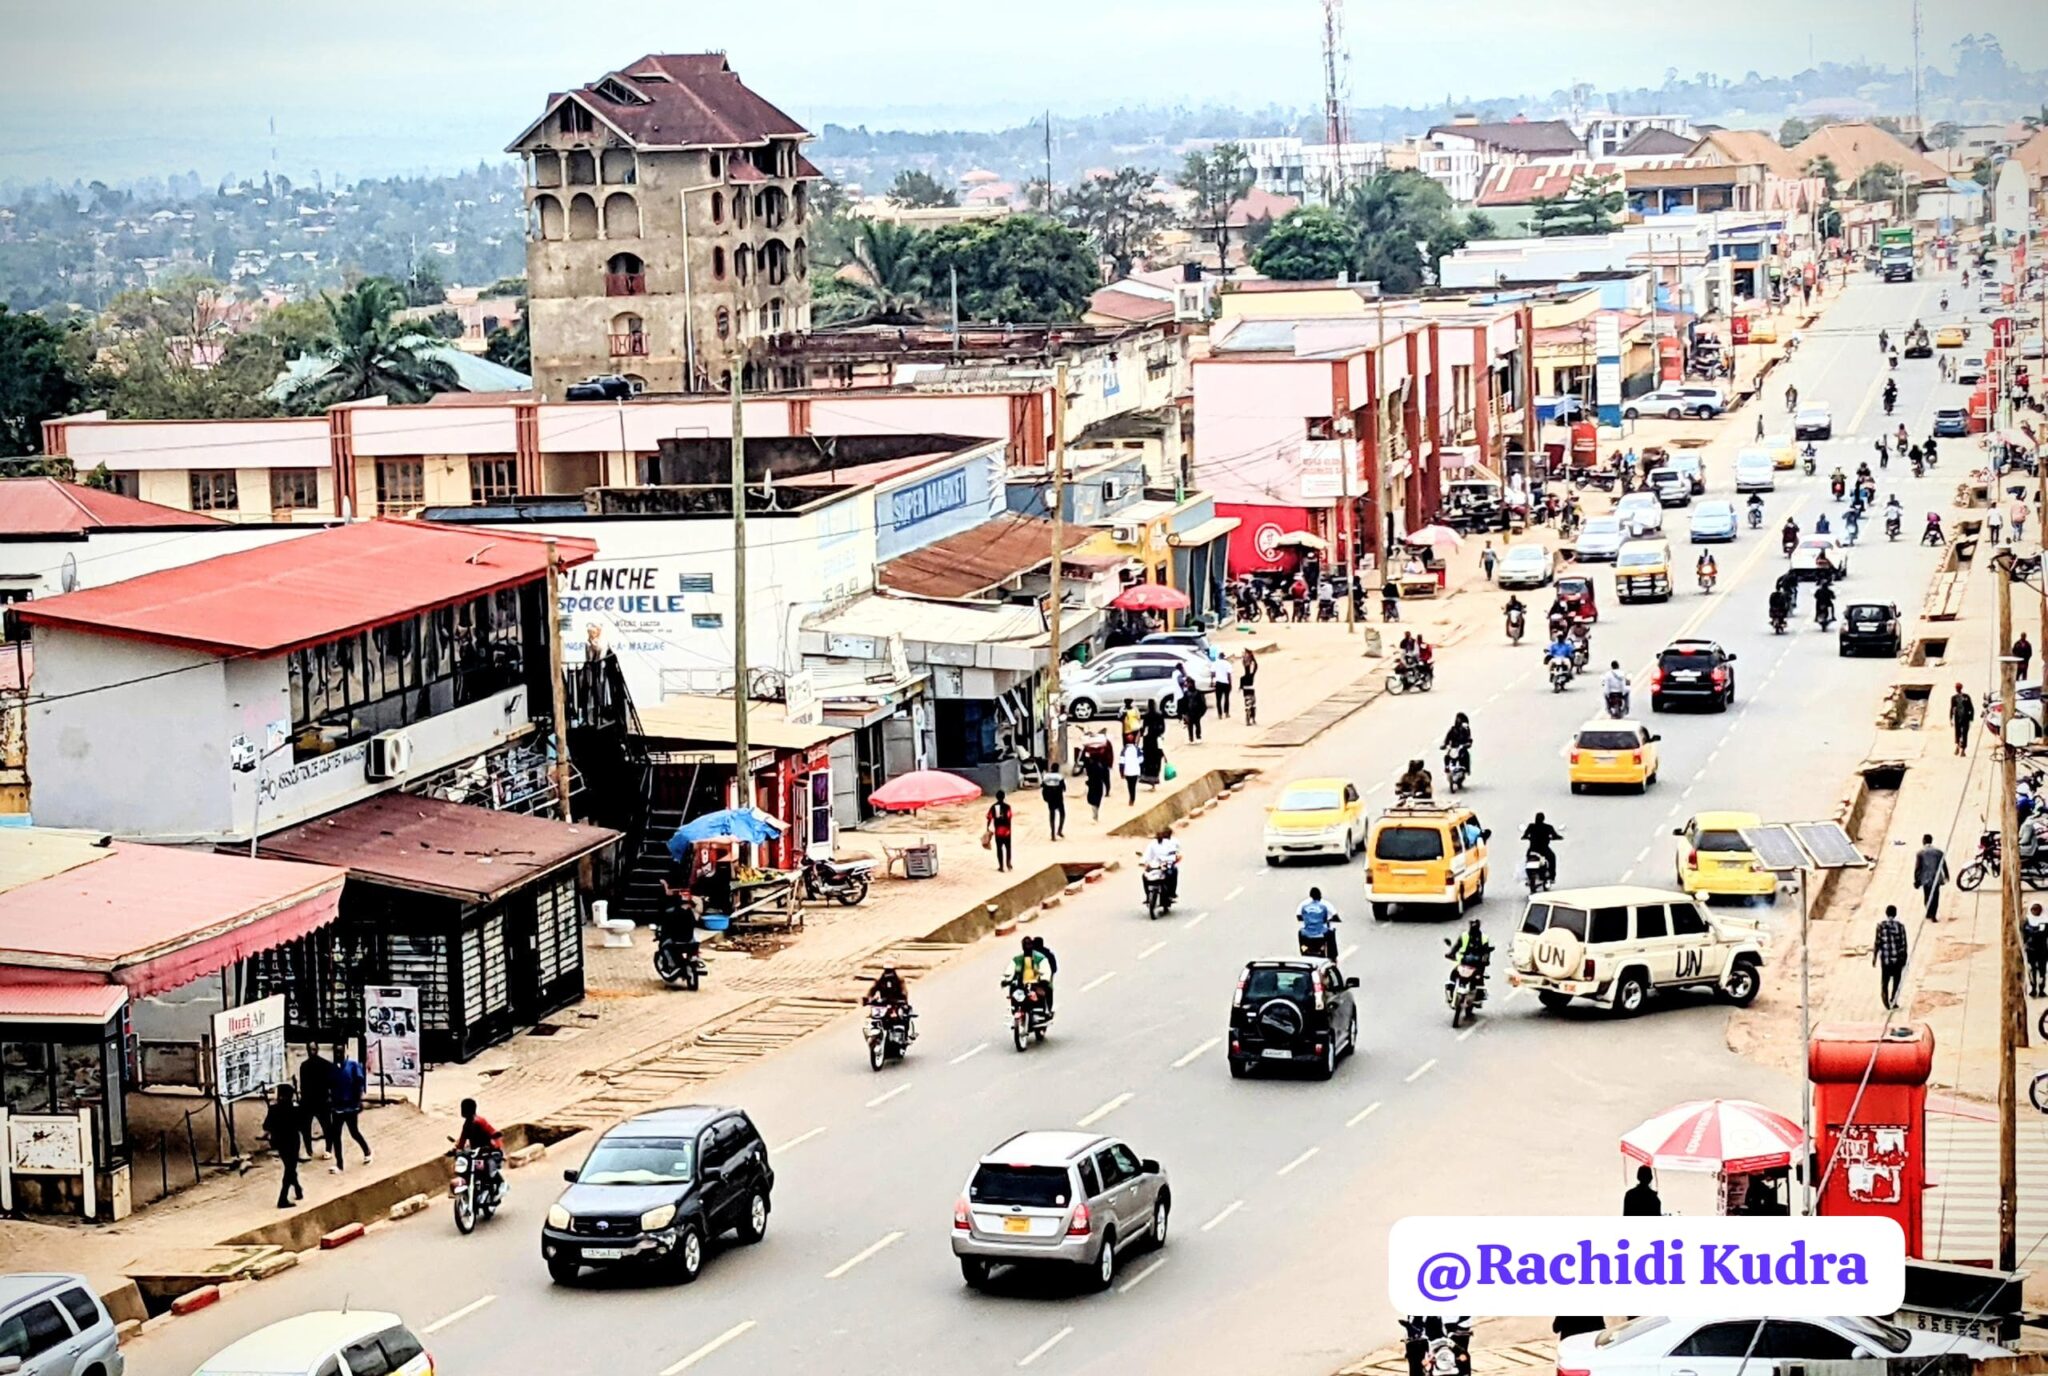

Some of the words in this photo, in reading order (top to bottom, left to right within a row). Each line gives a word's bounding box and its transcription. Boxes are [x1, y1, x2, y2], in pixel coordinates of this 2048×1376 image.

[893, 487, 926, 528] SUPER
[565, 568, 659, 591] LANCHE
[619, 595, 685, 613] UELE
[1538, 943, 1566, 968] UN
[1675, 949, 1702, 978] UN
